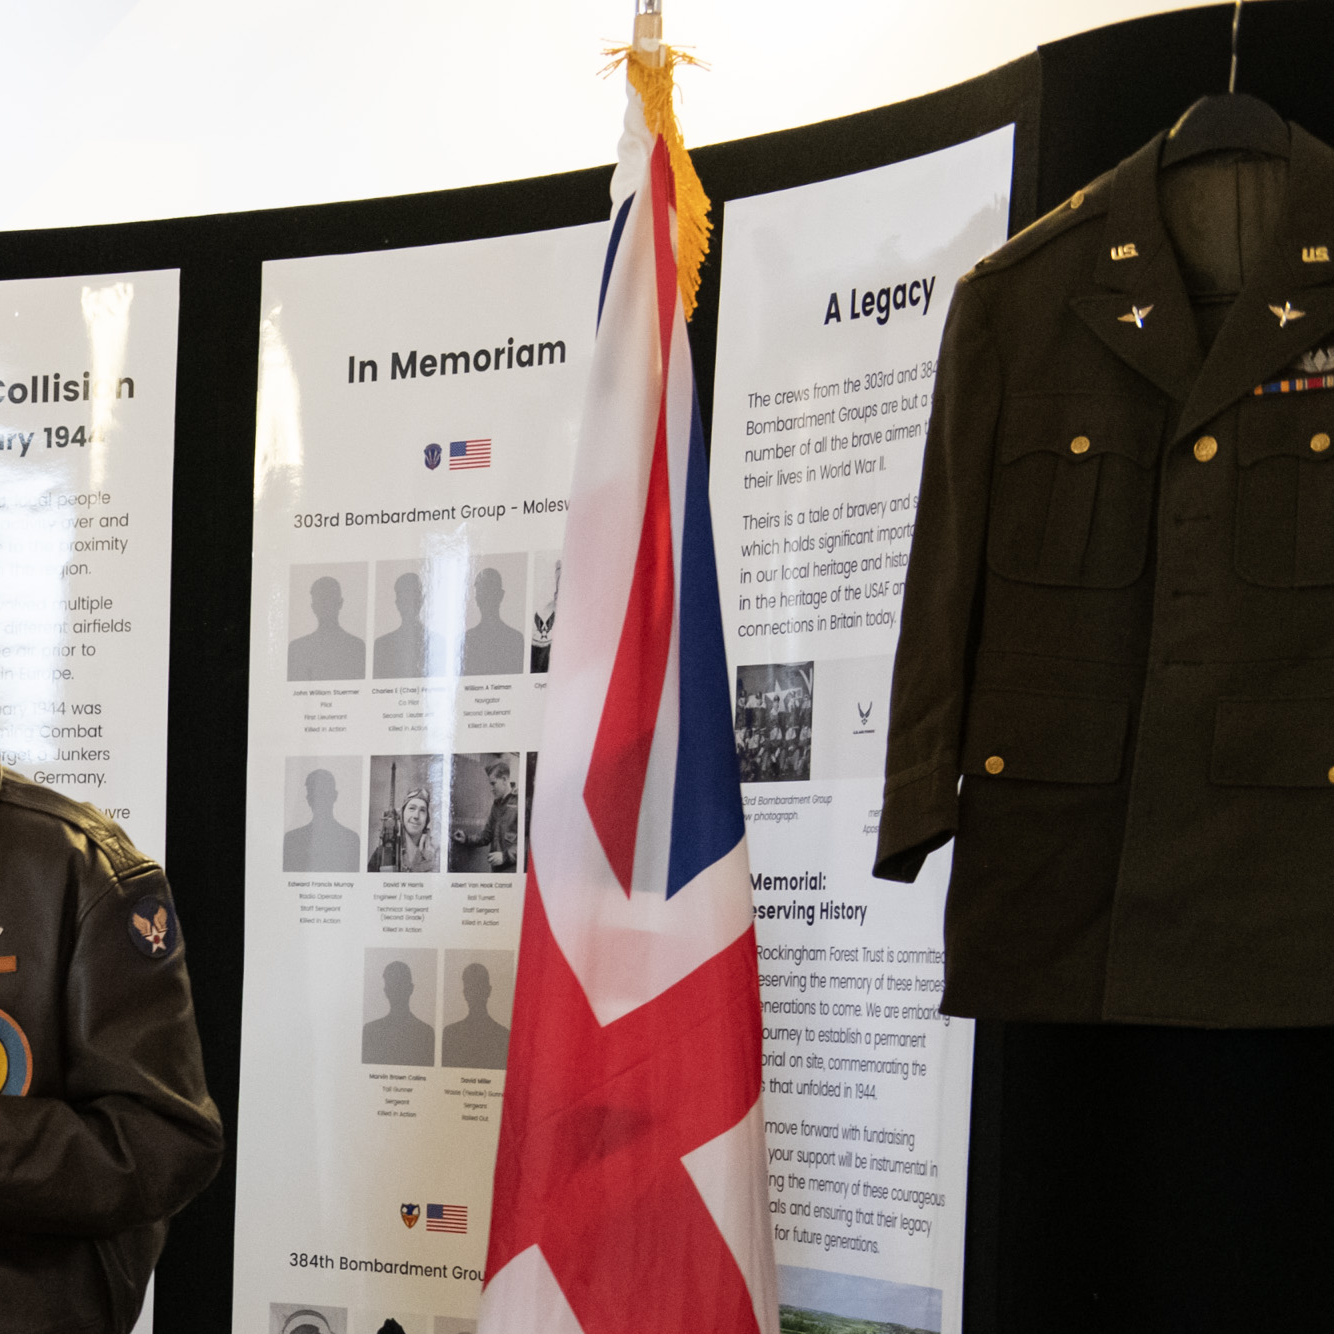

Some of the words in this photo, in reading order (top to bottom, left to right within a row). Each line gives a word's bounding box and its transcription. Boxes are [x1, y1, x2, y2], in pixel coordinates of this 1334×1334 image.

[824, 292, 841, 325] A
[851, 276, 935, 325] Legacy
[349, 356, 377, 383] In
[391, 337, 566, 380] Memoriam
[748, 392, 771, 408] The
[775, 389, 809, 405] crews
[814, 383, 839, 399] from
[844, 378, 861, 394] the
[864, 369, 894, 390] 303rd
[897, 364, 918, 384] and
[744, 471, 773, 489] their
[777, 469, 802, 485] lives
[807, 466, 816, 482] in
[820, 460, 851, 480] World
[854, 459, 876, 474] War
[294, 513, 339, 528] 303rd
[346, 506, 456, 526] Bombardment
[461, 505, 505, 521] Group
[73, 619, 131, 633] airfields
[56, 747, 110, 761] Junkers
[34, 771, 106, 788] Germany.
[750, 871, 826, 890] Memorial:
[753, 900, 815, 926] eserving
[820, 900, 867, 926] History
[757, 945, 826, 966] Rockingham
[830, 946, 858, 962] Forest
[862, 947, 884, 962] Trust
[887, 950, 894, 963] is
[765, 1121, 798, 1136] move
[801, 1120, 839, 1139] forward
[842, 1125, 860, 1140] with
[864, 1126, 915, 1152] fundraising
[290, 1253, 334, 1269] 384th
[340, 1257, 448, 1279] Bombardment
[452, 1265, 486, 1282] Grou
